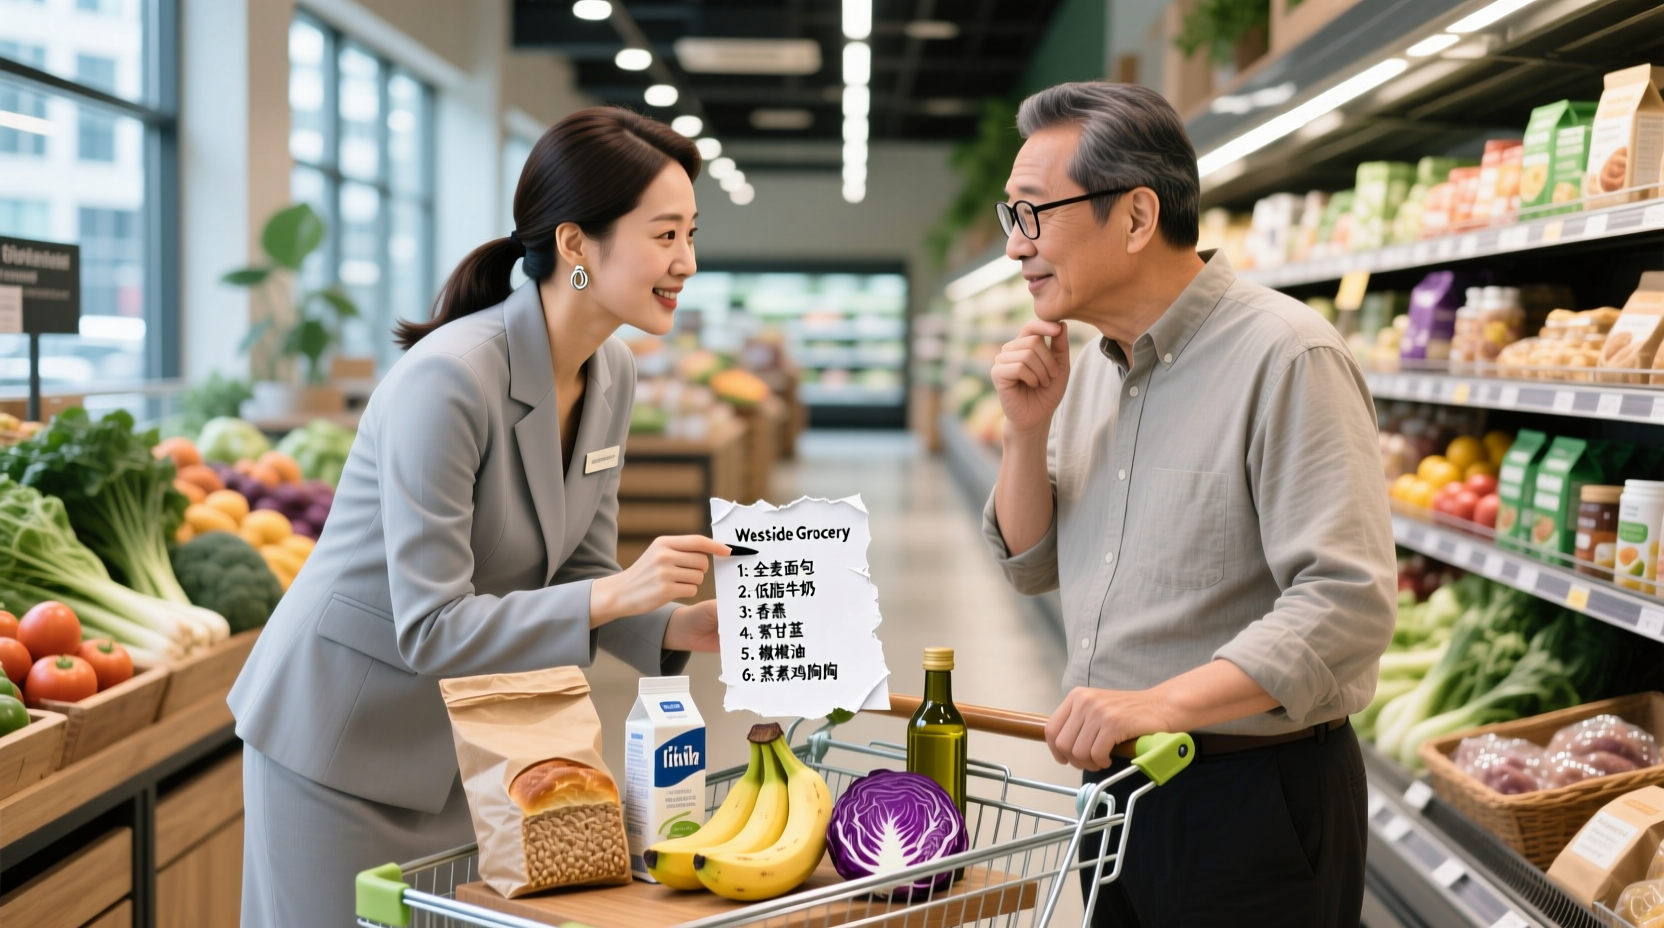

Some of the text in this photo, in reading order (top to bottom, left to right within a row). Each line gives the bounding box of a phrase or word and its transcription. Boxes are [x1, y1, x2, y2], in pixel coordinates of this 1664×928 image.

[796, 526, 850, 542] Grocery
[755, 580, 816, 599] 低脂牛奶
